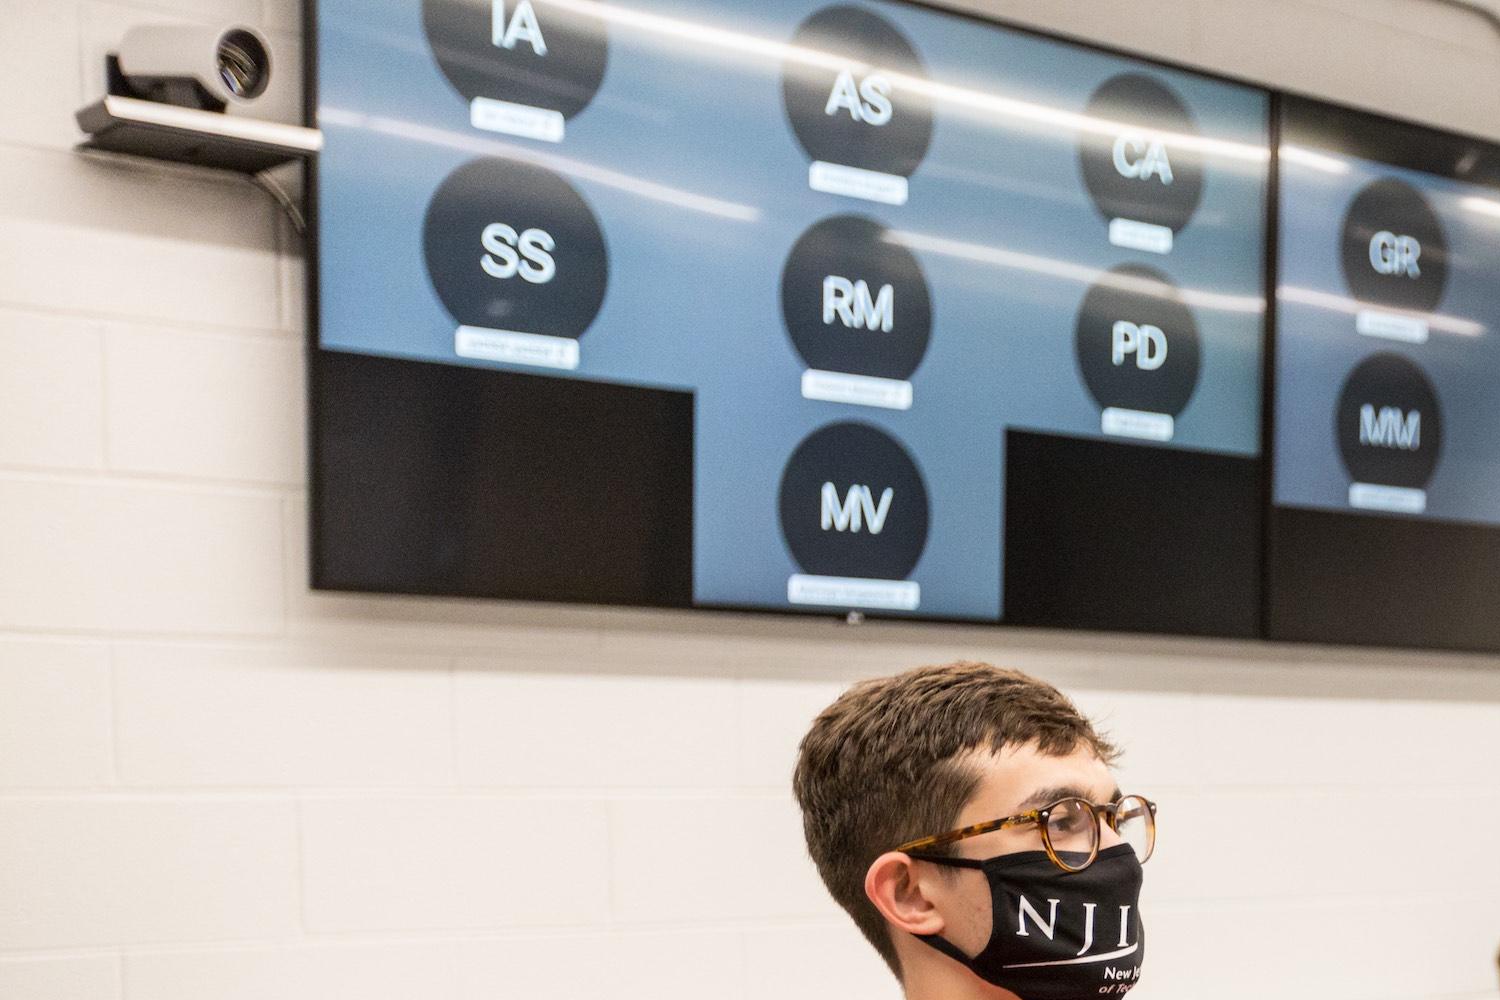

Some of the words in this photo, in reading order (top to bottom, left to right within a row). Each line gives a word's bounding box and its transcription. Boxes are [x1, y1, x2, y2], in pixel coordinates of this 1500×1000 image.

[491, 0, 549, 57] IA
[825, 70, 893, 126] AS
[1112, 137, 1174, 185] CA
[480, 222, 556, 284] SS
[1369, 230, 1421, 279] GR
[822, 275, 894, 333] RM
[1112, 320, 1168, 371] PD
[1360, 403, 1420, 452] MM
[821, 481, 894, 534] MV
[1016, 894, 1132, 956] NJI
[1098, 984, 1115, 994] of
[1104, 966, 1131, 980] New
